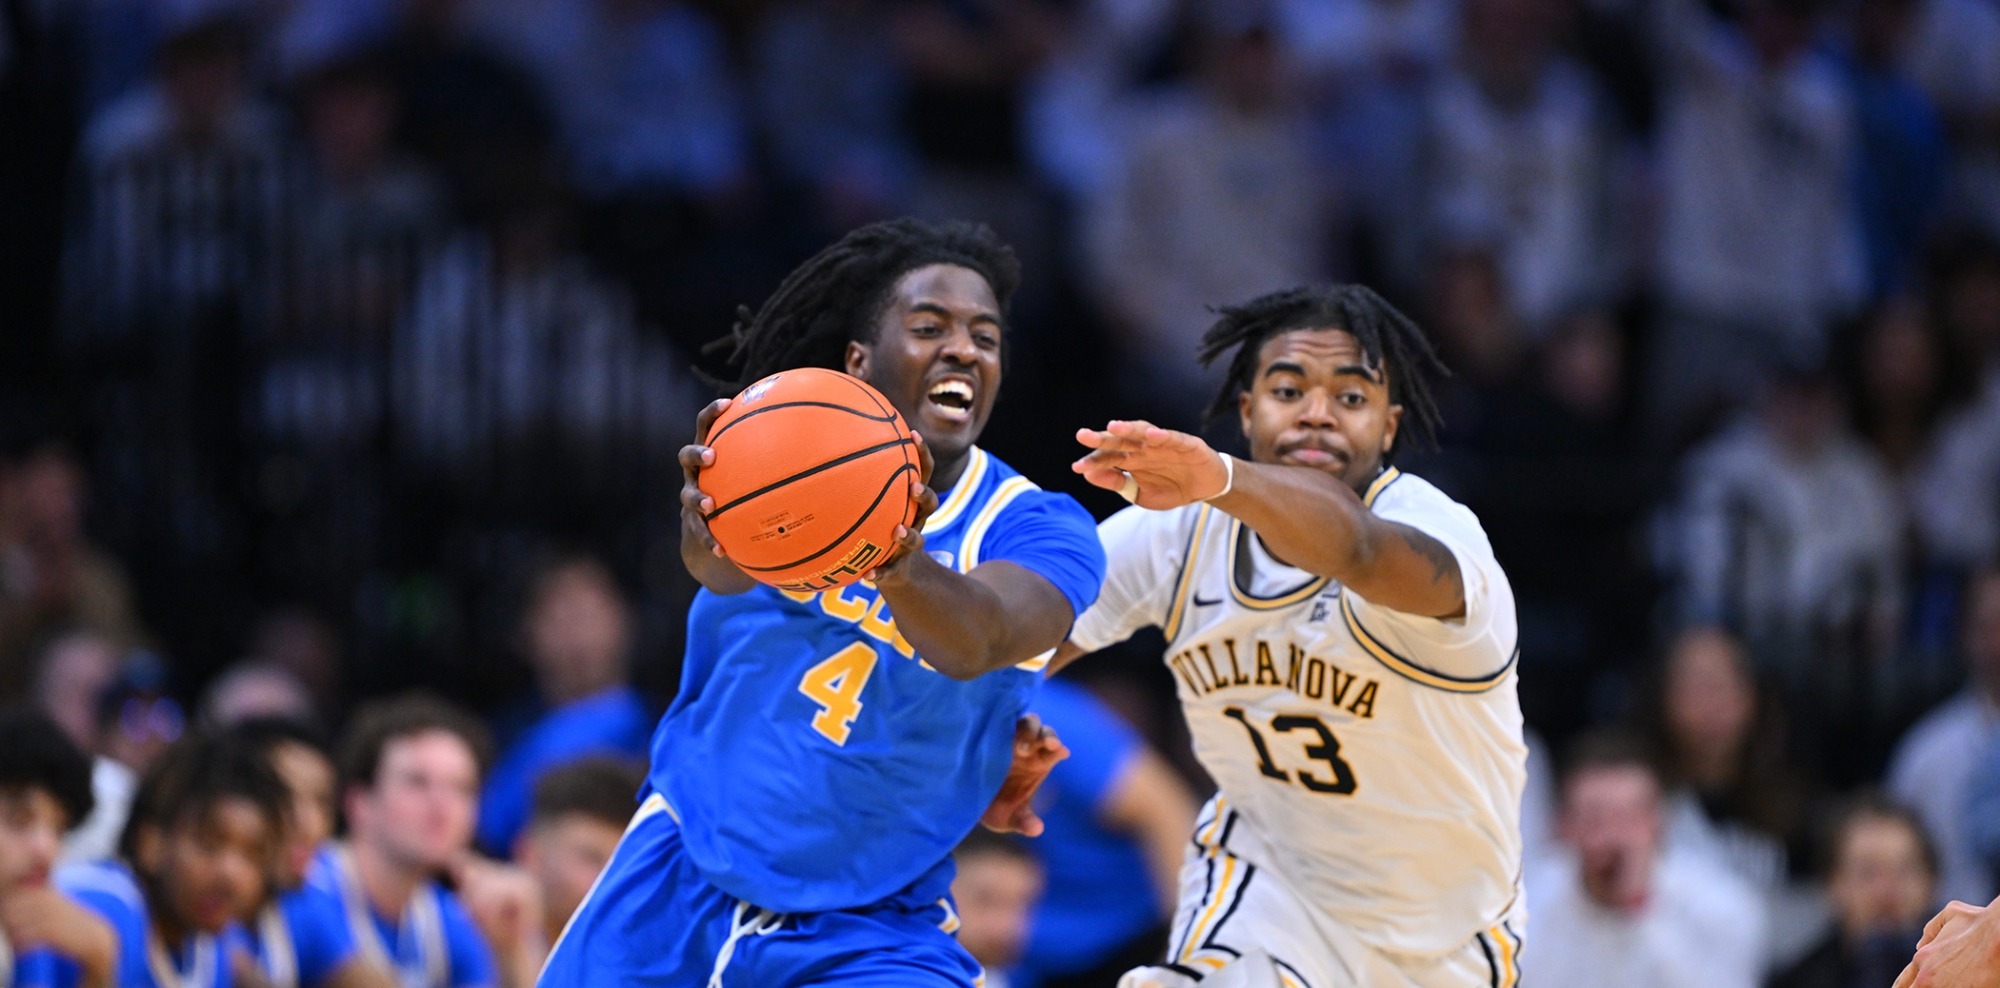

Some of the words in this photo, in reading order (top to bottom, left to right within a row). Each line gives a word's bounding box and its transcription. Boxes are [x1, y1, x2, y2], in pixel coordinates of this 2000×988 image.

[779, 578, 937, 672] CL
[798, 641, 878, 747] 4
[1172, 638, 1379, 718] VILLANOVA
[1223, 707, 1358, 796] 13
